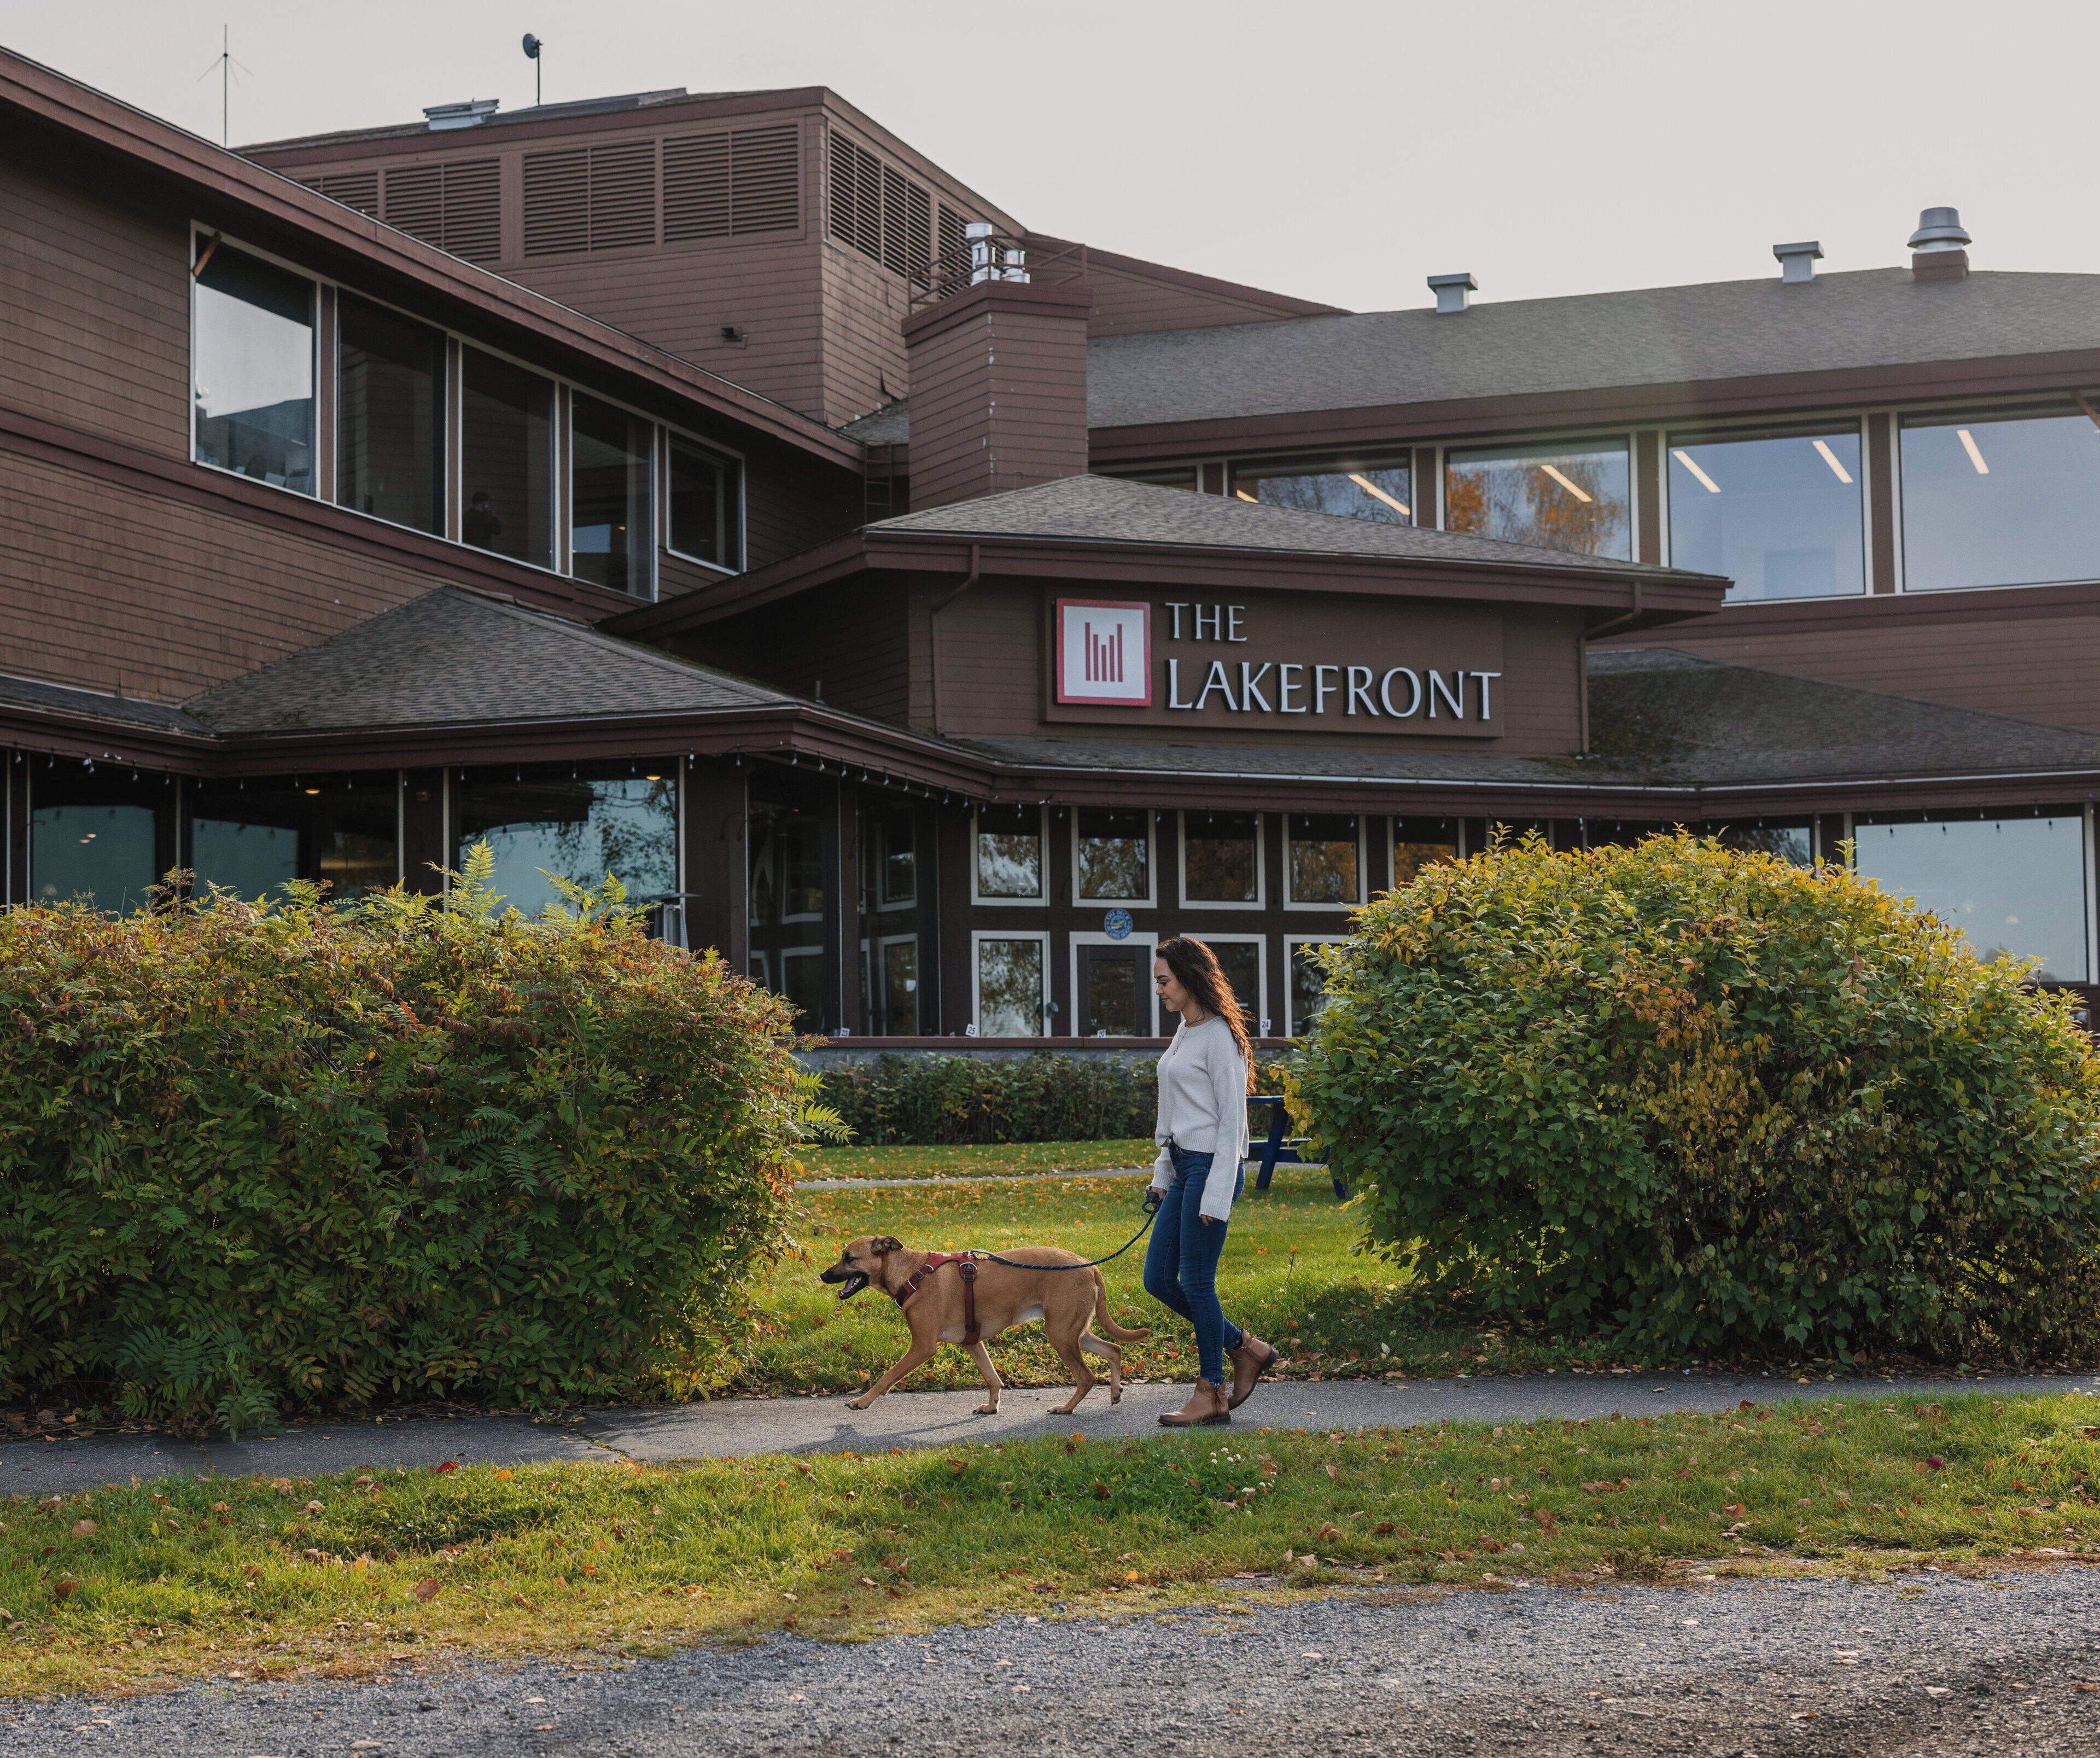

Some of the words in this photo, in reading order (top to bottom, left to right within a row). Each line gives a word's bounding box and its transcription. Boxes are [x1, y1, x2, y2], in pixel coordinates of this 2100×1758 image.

[1165, 602, 1247, 642] THE
[1169, 659, 1502, 720] LAKEFRONT
[1116, 910, 1130, 920] DECK
[968, 1026, 976, 1035] 25
